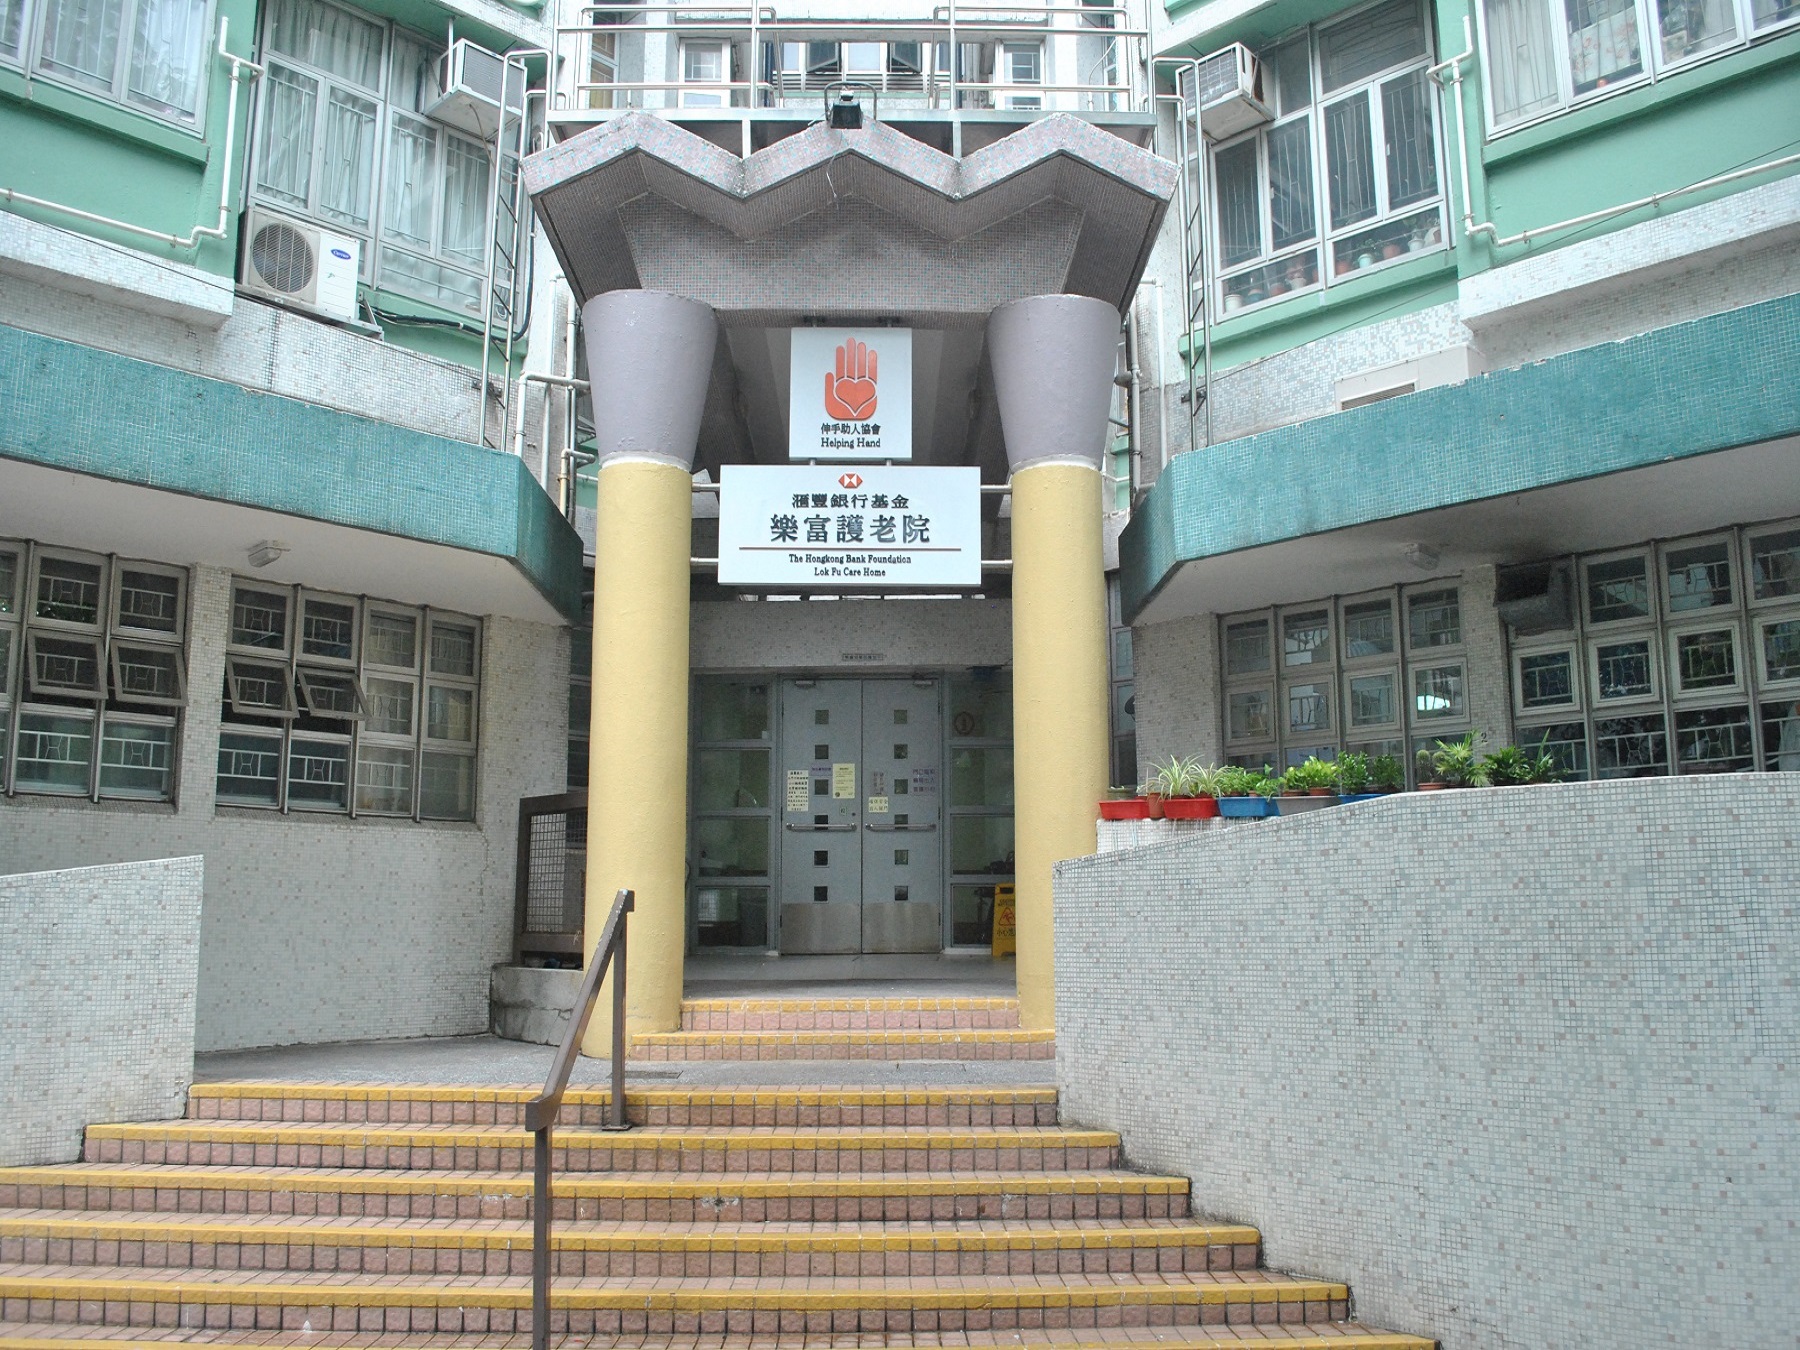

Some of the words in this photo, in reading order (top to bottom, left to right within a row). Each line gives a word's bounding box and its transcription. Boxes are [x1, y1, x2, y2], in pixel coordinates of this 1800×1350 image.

[821, 423, 881, 435] 伸手助人協會
[821, 437, 854, 449] Helping
[857, 437, 881, 448] Hand
[792, 493, 909, 509] 滙豐銀行基金
[770, 514, 930, 543] 樂富護老院
[789, 554, 803, 563] The
[805, 554, 844, 565] Hongkong
[846, 554, 866, 563] Bank
[868, 555, 911, 564] Foundation
[814, 567, 829, 577] Lok
[831, 568, 841, 576] Fu
[843, 568, 861, 577] Care
[863, 568, 886, 577] Home
